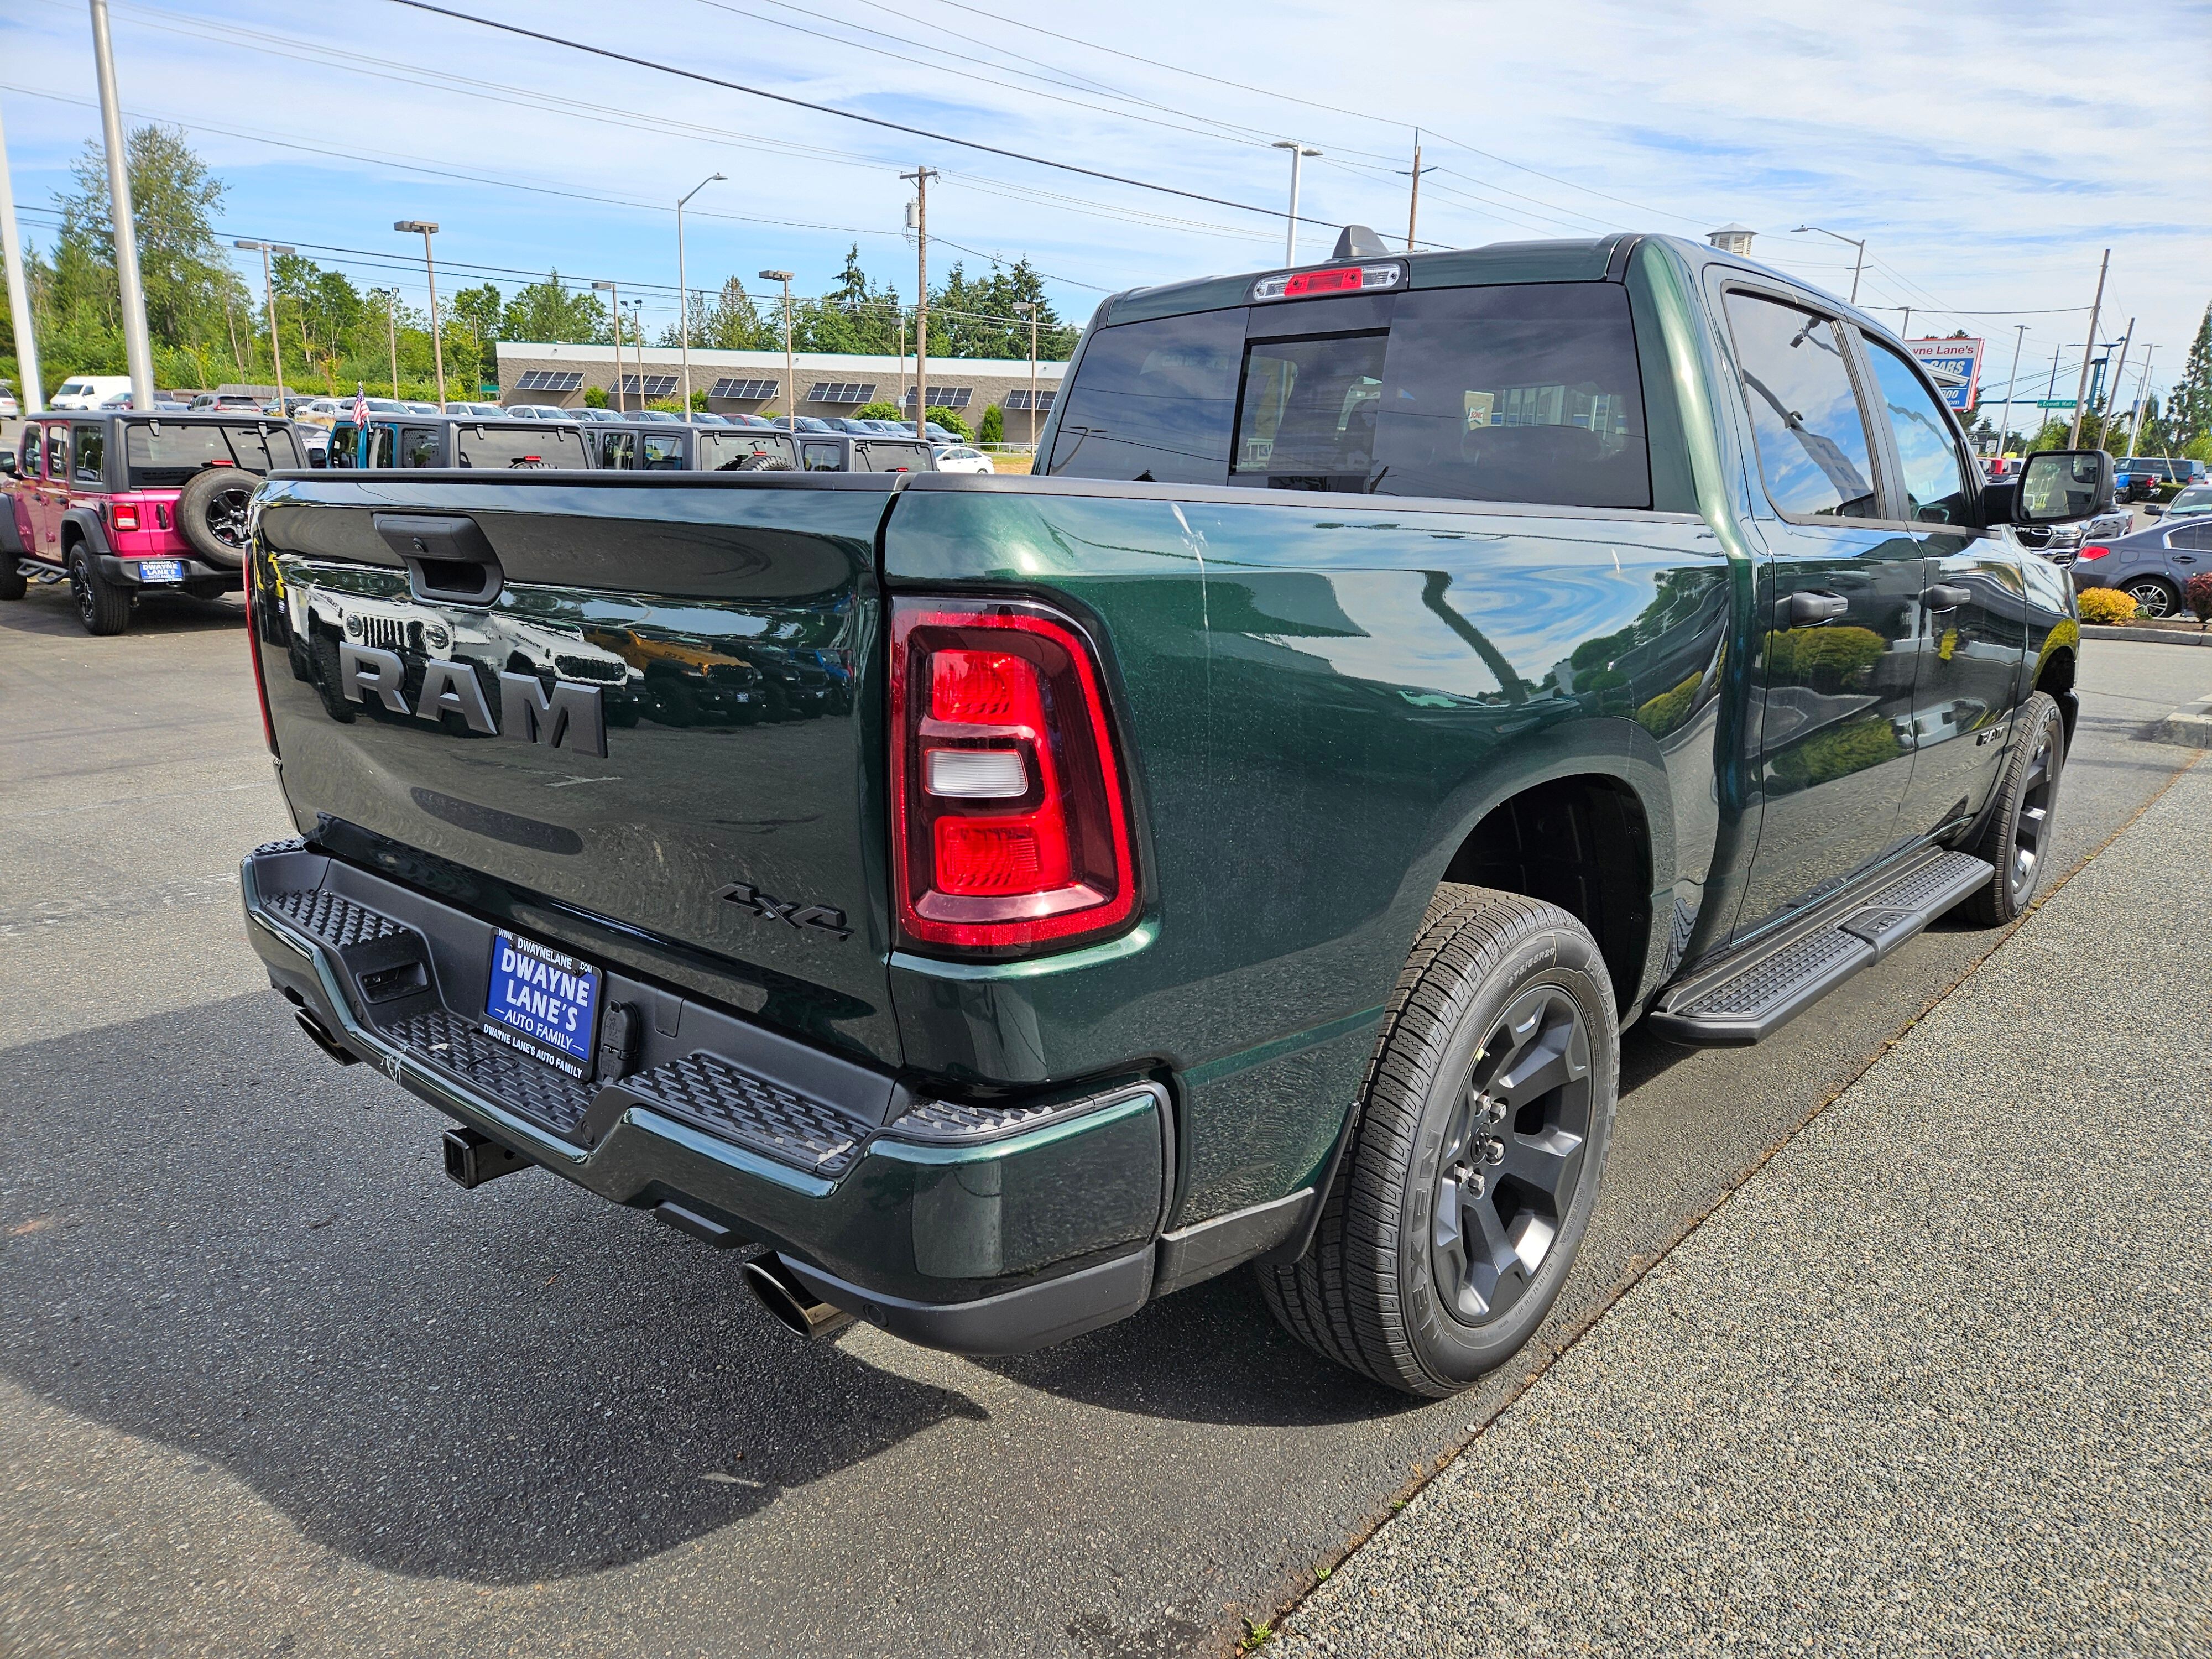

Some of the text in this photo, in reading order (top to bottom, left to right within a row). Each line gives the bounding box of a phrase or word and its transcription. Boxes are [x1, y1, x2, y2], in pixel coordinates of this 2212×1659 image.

[1937, 345, 1974, 354] Lane's
[340, 641, 608, 759] RAM
[498, 927, 593, 974] WWW. DWAYNELANE .COM
[1507, 947, 1555, 988] 275/55R20
[501, 948, 590, 1007] DWAYNE
[504, 1009, 534, 1032] AUTO
[536, 1022, 573, 1051] FAMILY
[505, 979, 578, 1032] LANE'S
[483, 1023, 583, 1079] DWAYNE LANE'S AUTO FAMILY
[1410, 1129, 1442, 1355] NEXEN
